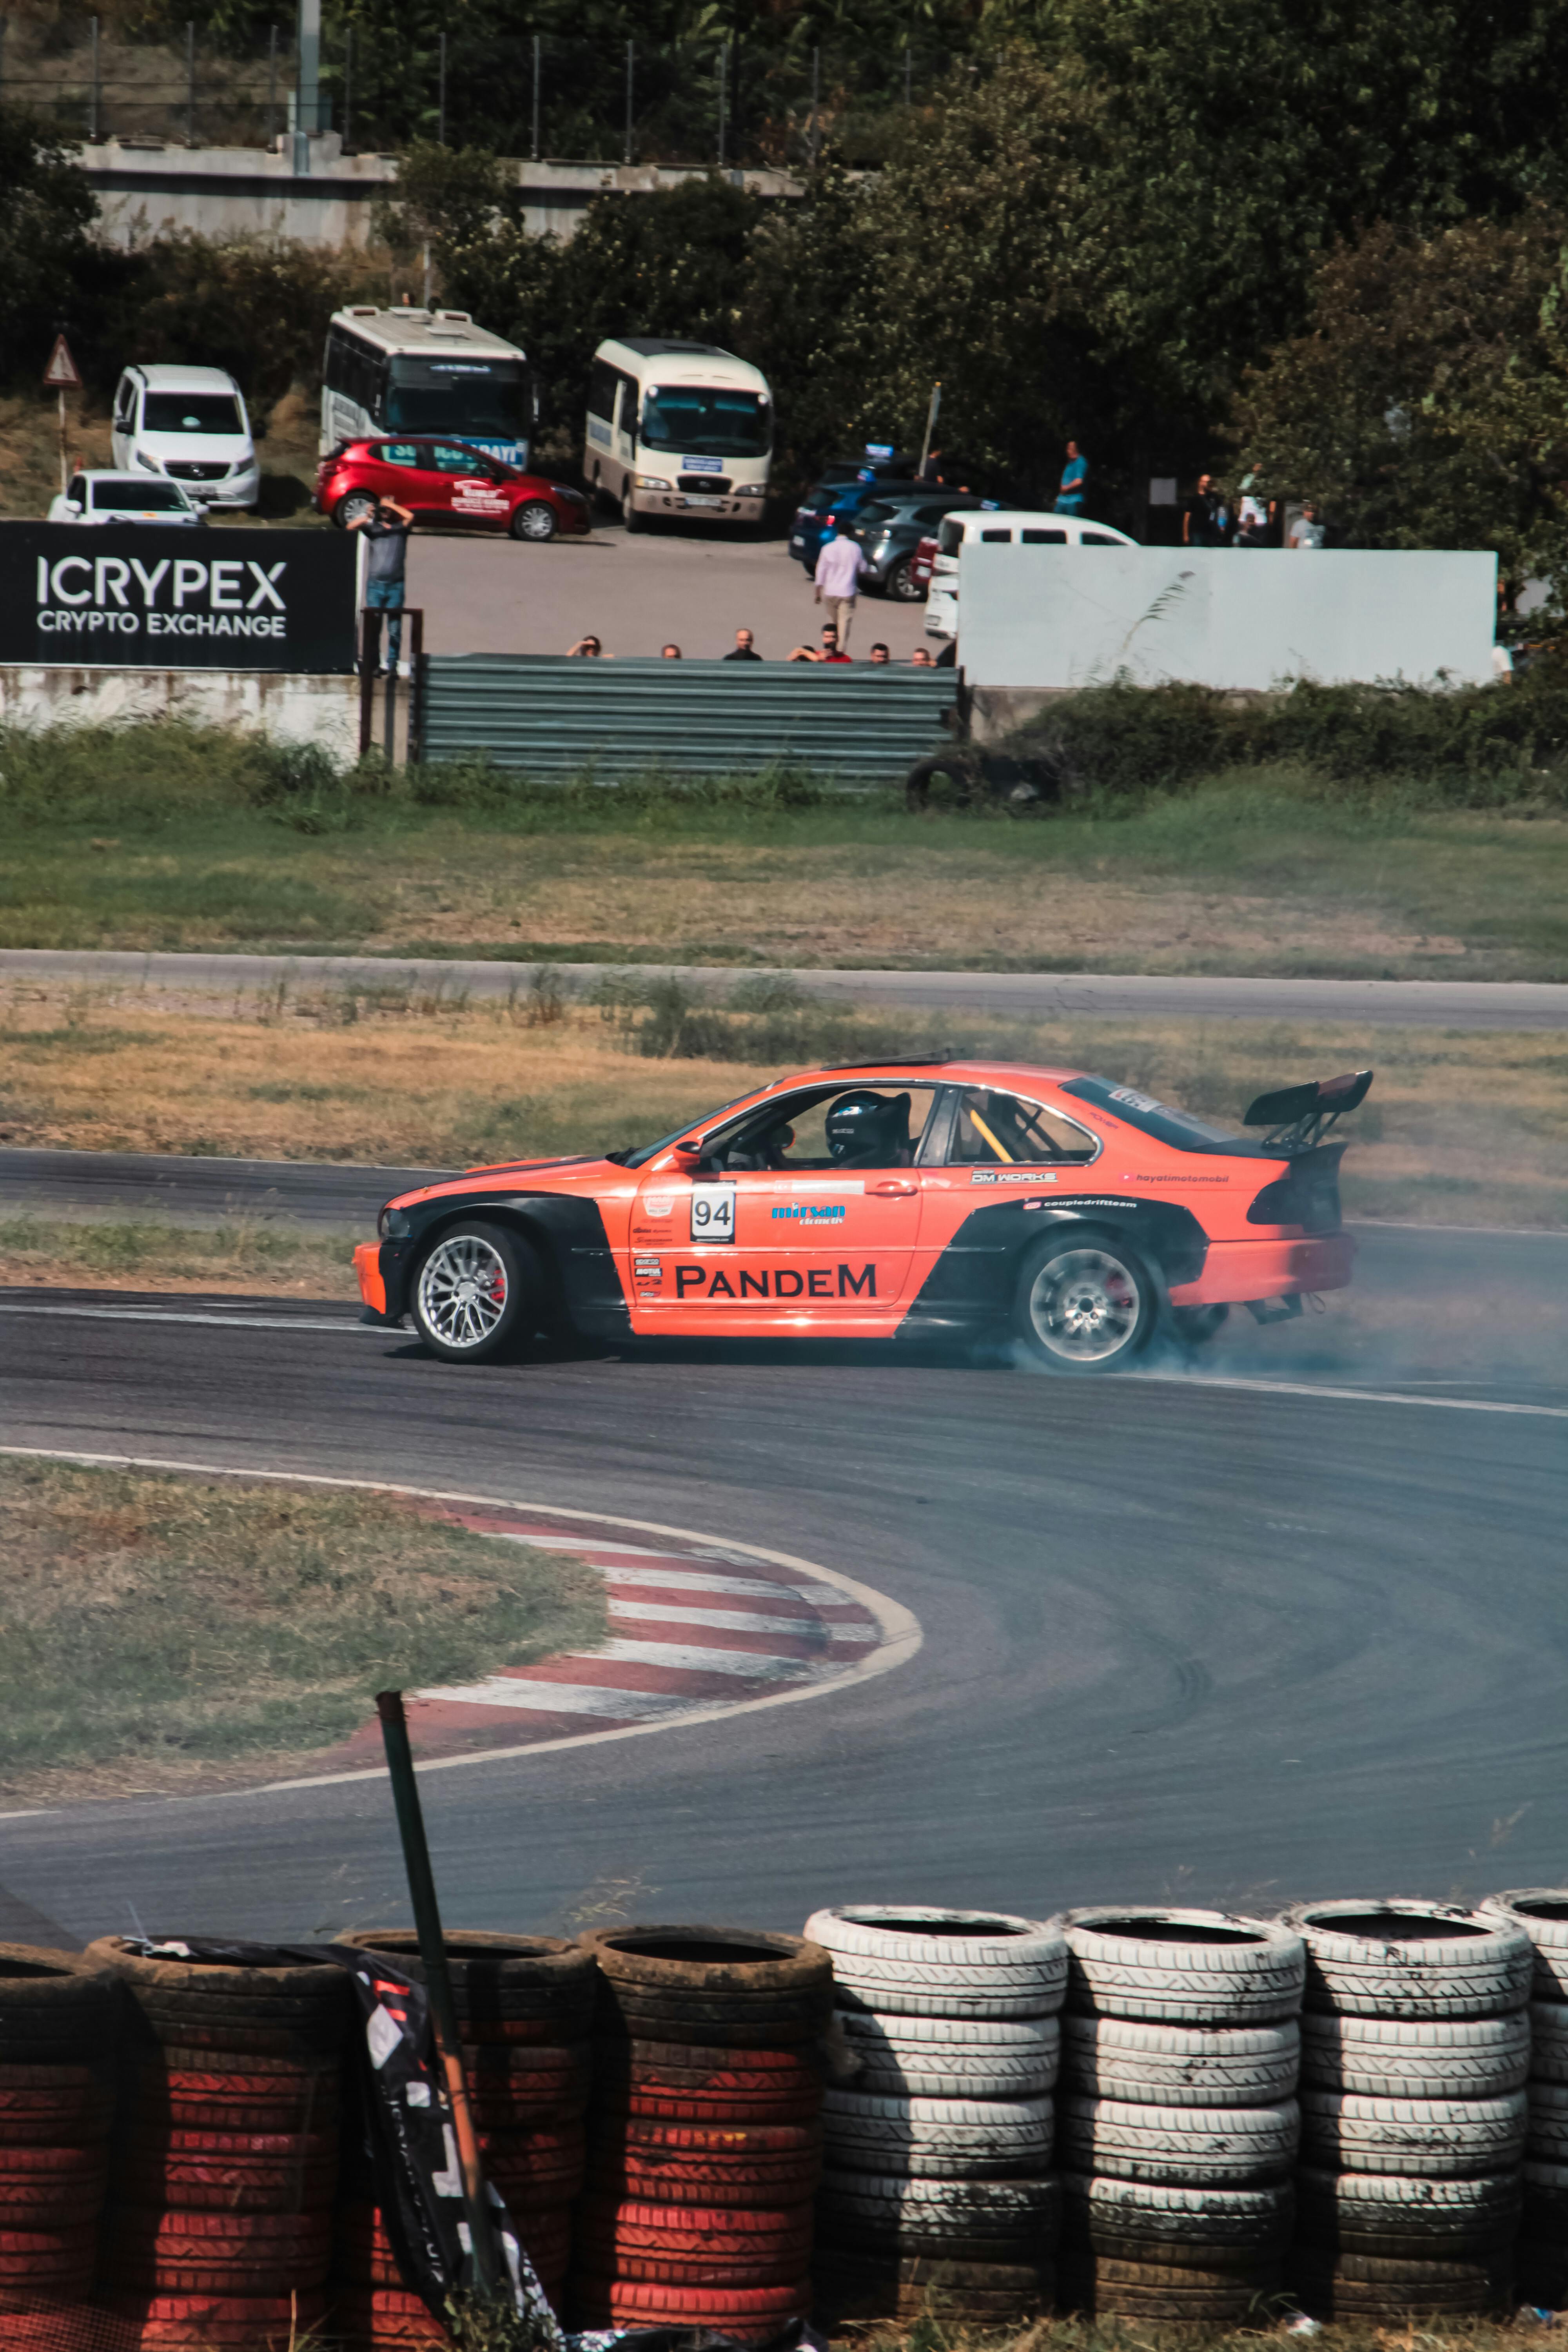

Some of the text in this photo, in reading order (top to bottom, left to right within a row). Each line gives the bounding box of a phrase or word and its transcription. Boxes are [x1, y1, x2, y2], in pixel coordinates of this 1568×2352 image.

[37, 555, 287, 610] ICRYPEX
[36, 610, 287, 637] CRYPTO EXCHANGE
[998, 1172, 1056, 1181] WORKS
[1136, 1174, 1229, 1183] hayatimotomobil
[771, 1202, 846, 1218] mirsan
[1044, 1200, 1138, 1208] coupledriftteam
[695, 1200, 731, 1226] 94
[799, 1217, 845, 1225] otomotiv
